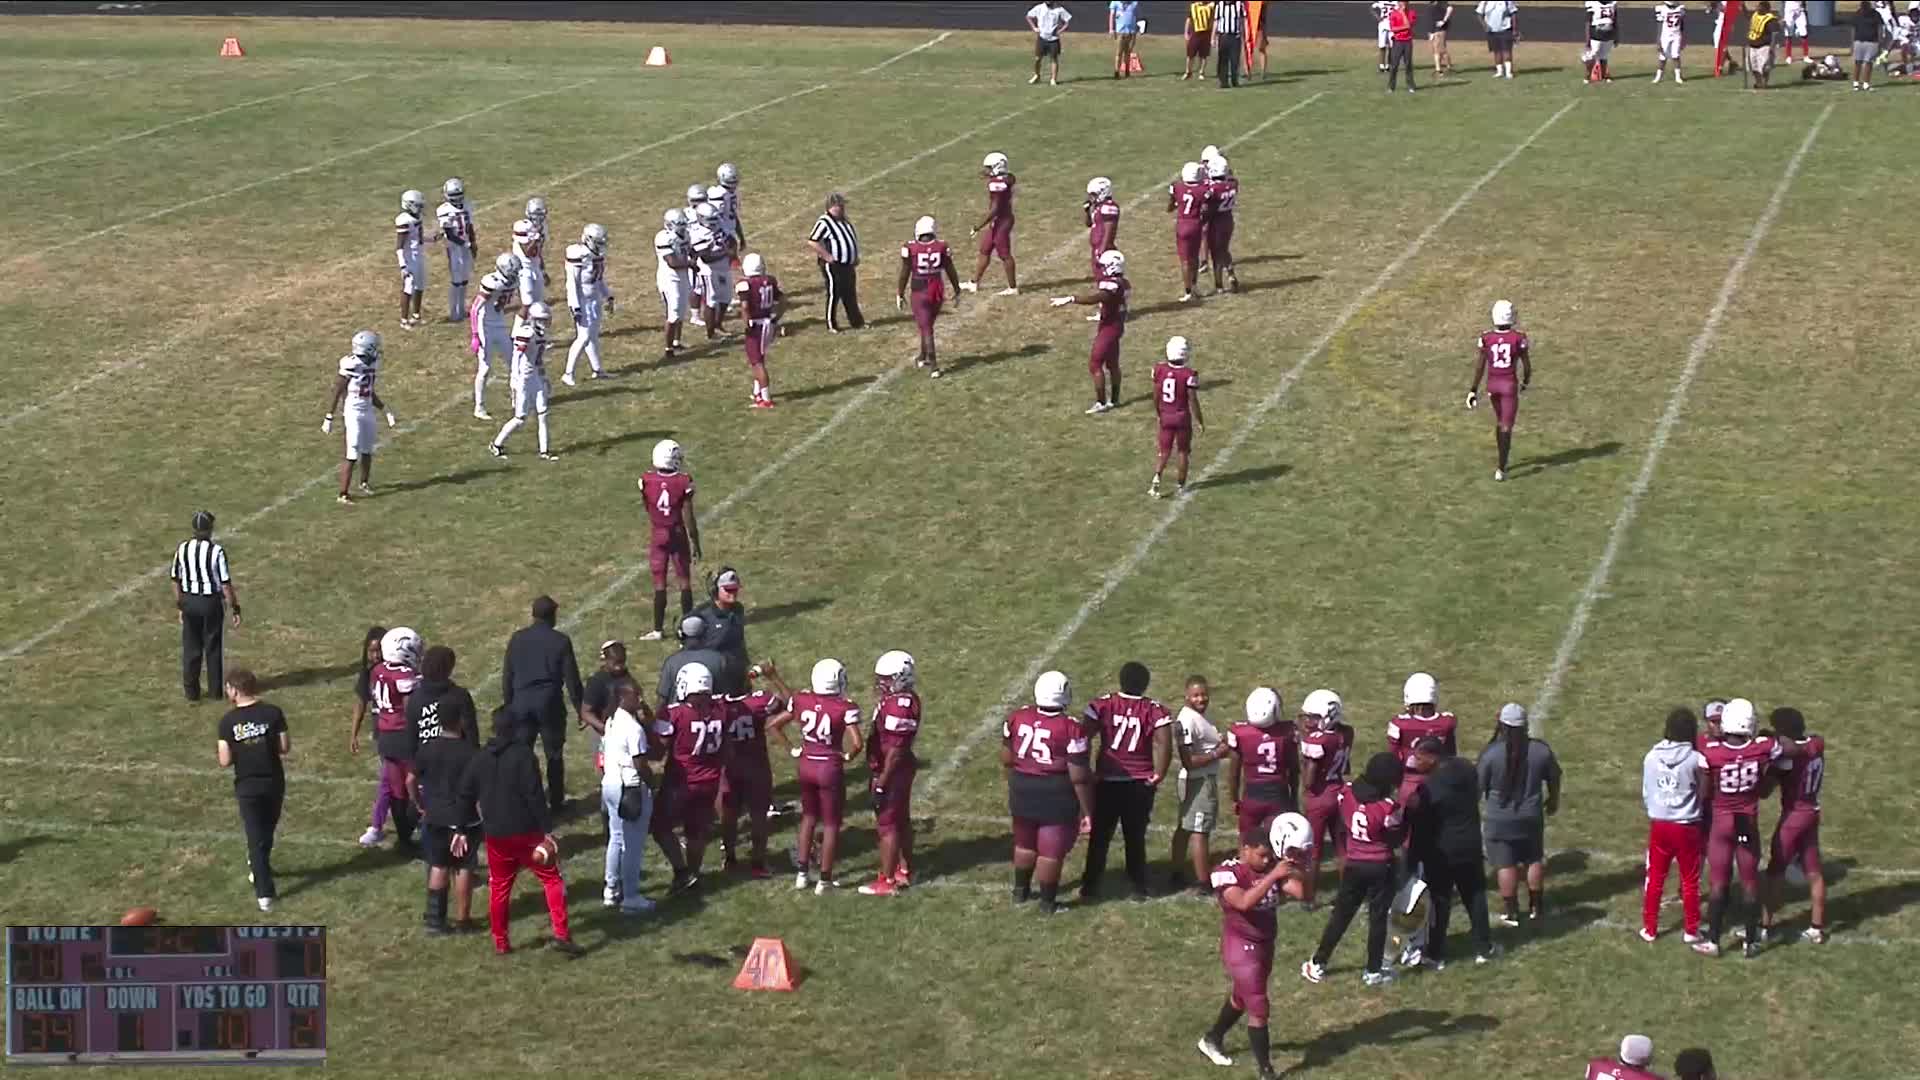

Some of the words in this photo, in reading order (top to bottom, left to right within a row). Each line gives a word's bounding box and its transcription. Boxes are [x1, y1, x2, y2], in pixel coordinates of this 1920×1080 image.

[1183, 193, 1194, 215] 7
[917, 252, 941, 274] 52
[759, 285, 773, 309] 10
[1491, 343, 1512, 369] 13
[1162, 378, 1176, 403] 9
[656, 489, 671, 516] 4
[690, 719, 722, 756] 73
[800, 710, 832, 745] 24
[1111, 714, 1141, 752] 77
[1017, 723, 1053, 765] 75
[1256, 741, 1277, 773] 3
[1351, 811, 1371, 842] 6
